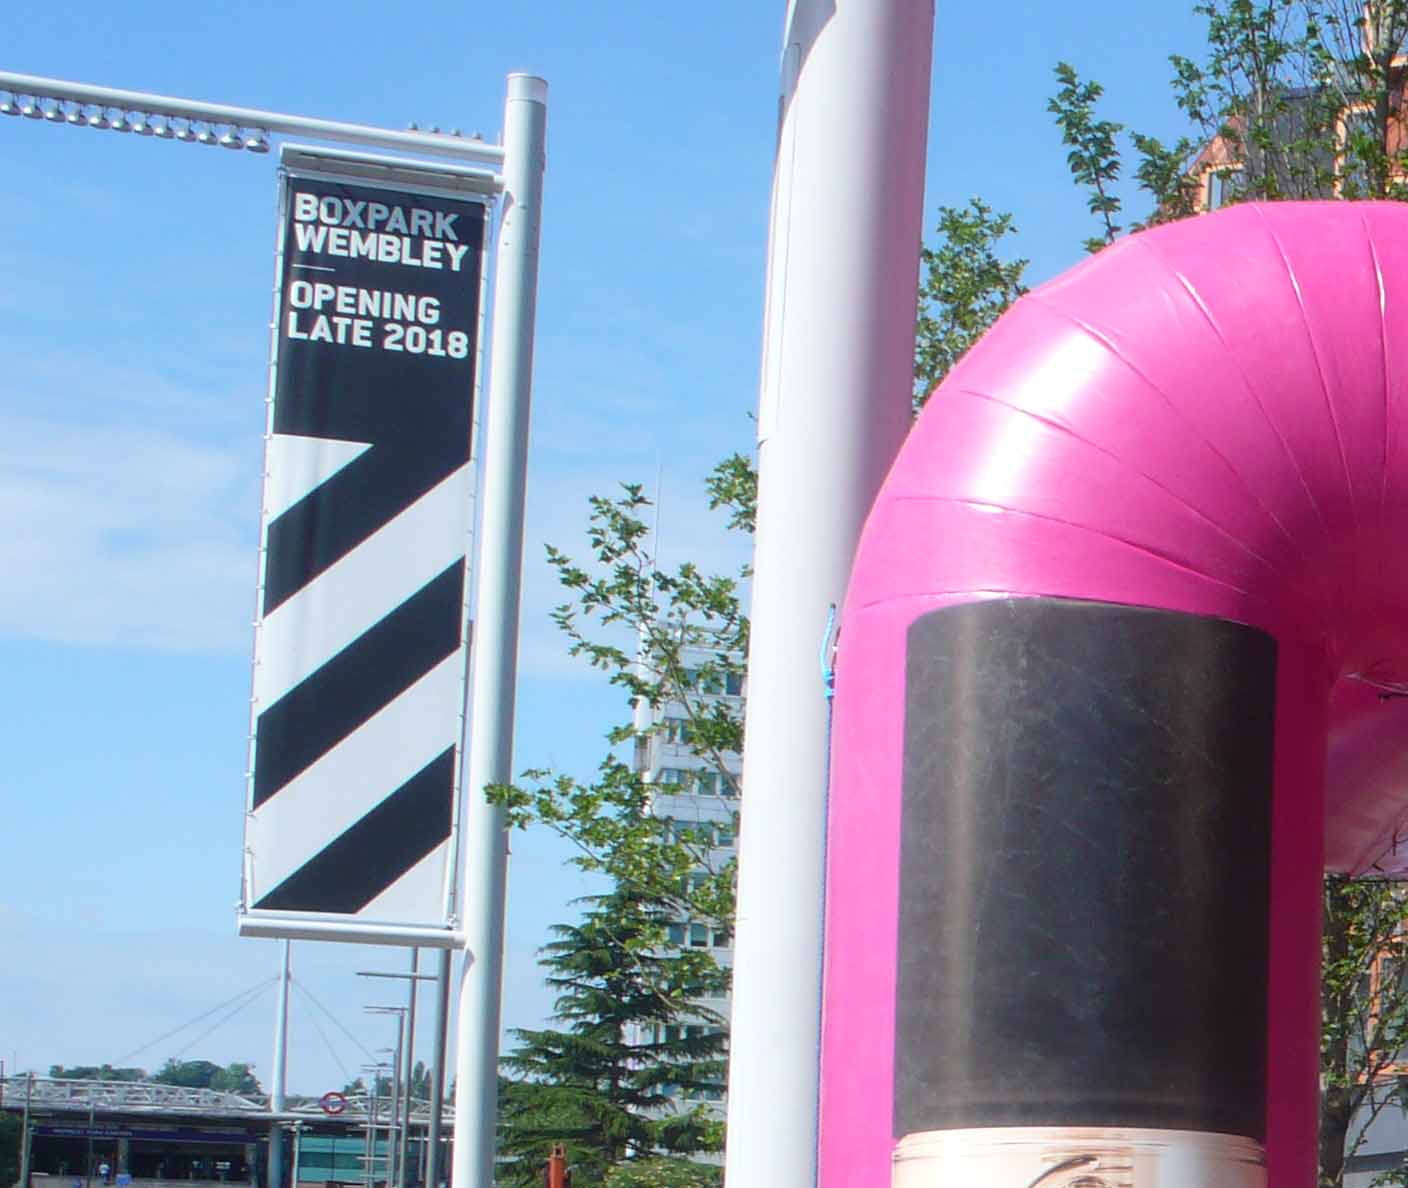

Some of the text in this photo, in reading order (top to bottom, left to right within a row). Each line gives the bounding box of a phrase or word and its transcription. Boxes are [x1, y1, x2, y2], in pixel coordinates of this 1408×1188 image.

[294, 192, 460, 241] BOXPARK
[293, 222, 469, 272] WEMBLEY
[289, 280, 441, 325] OPENING
[287, 311, 469, 359] LATE 2018
